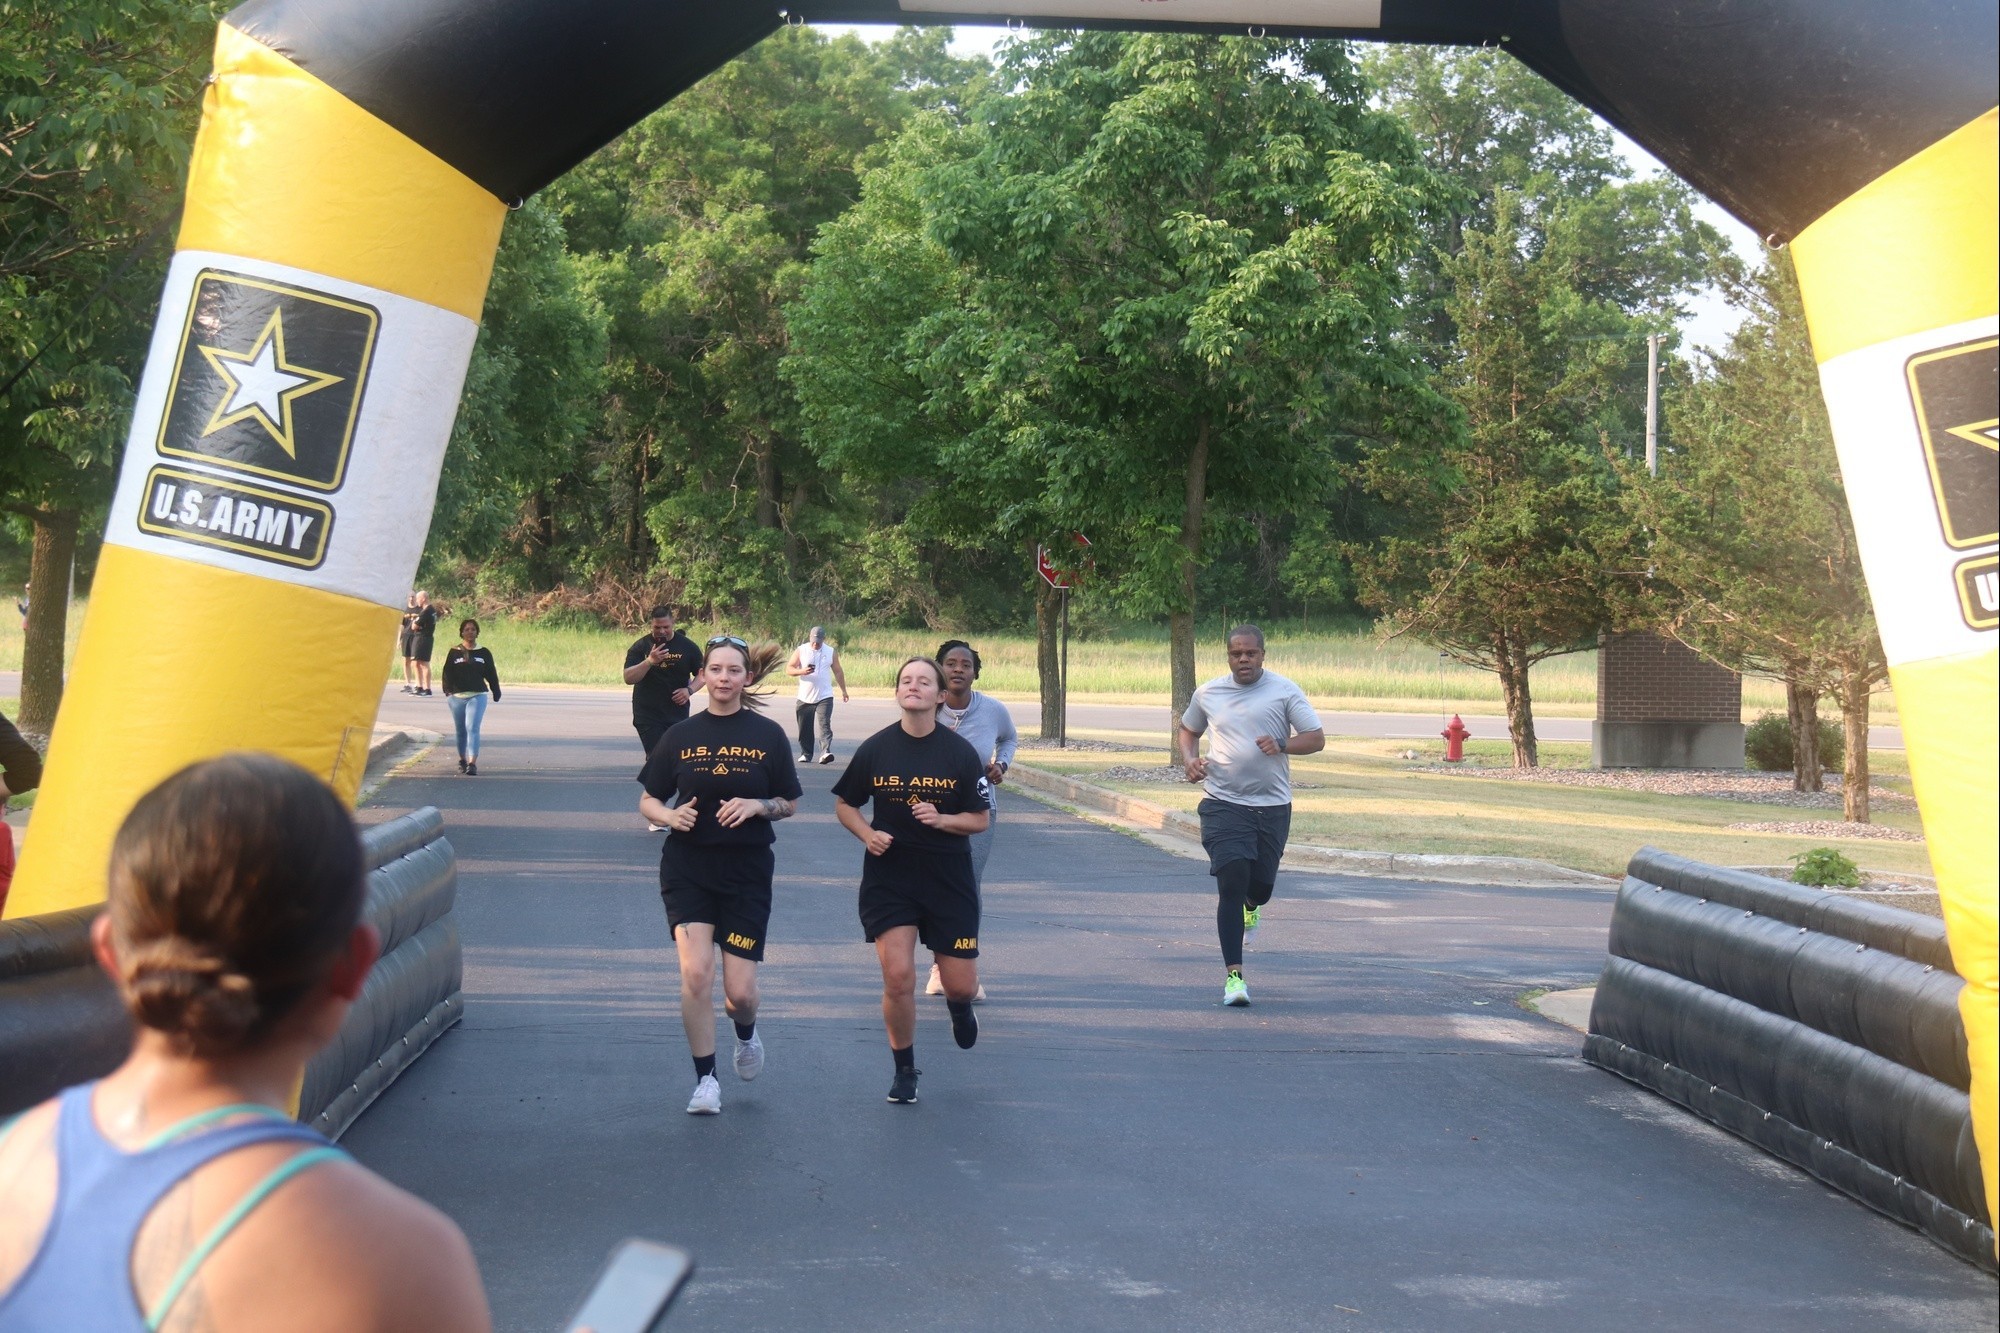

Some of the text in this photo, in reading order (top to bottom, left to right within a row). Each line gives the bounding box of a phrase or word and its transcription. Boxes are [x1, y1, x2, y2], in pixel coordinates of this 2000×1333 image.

[681, 746, 766, 760] U.S. ARMY
[873, 776, 957, 789] U.S. ARMY
[726, 932, 757, 950] ARMY
[954, 938, 977, 949] ARM
